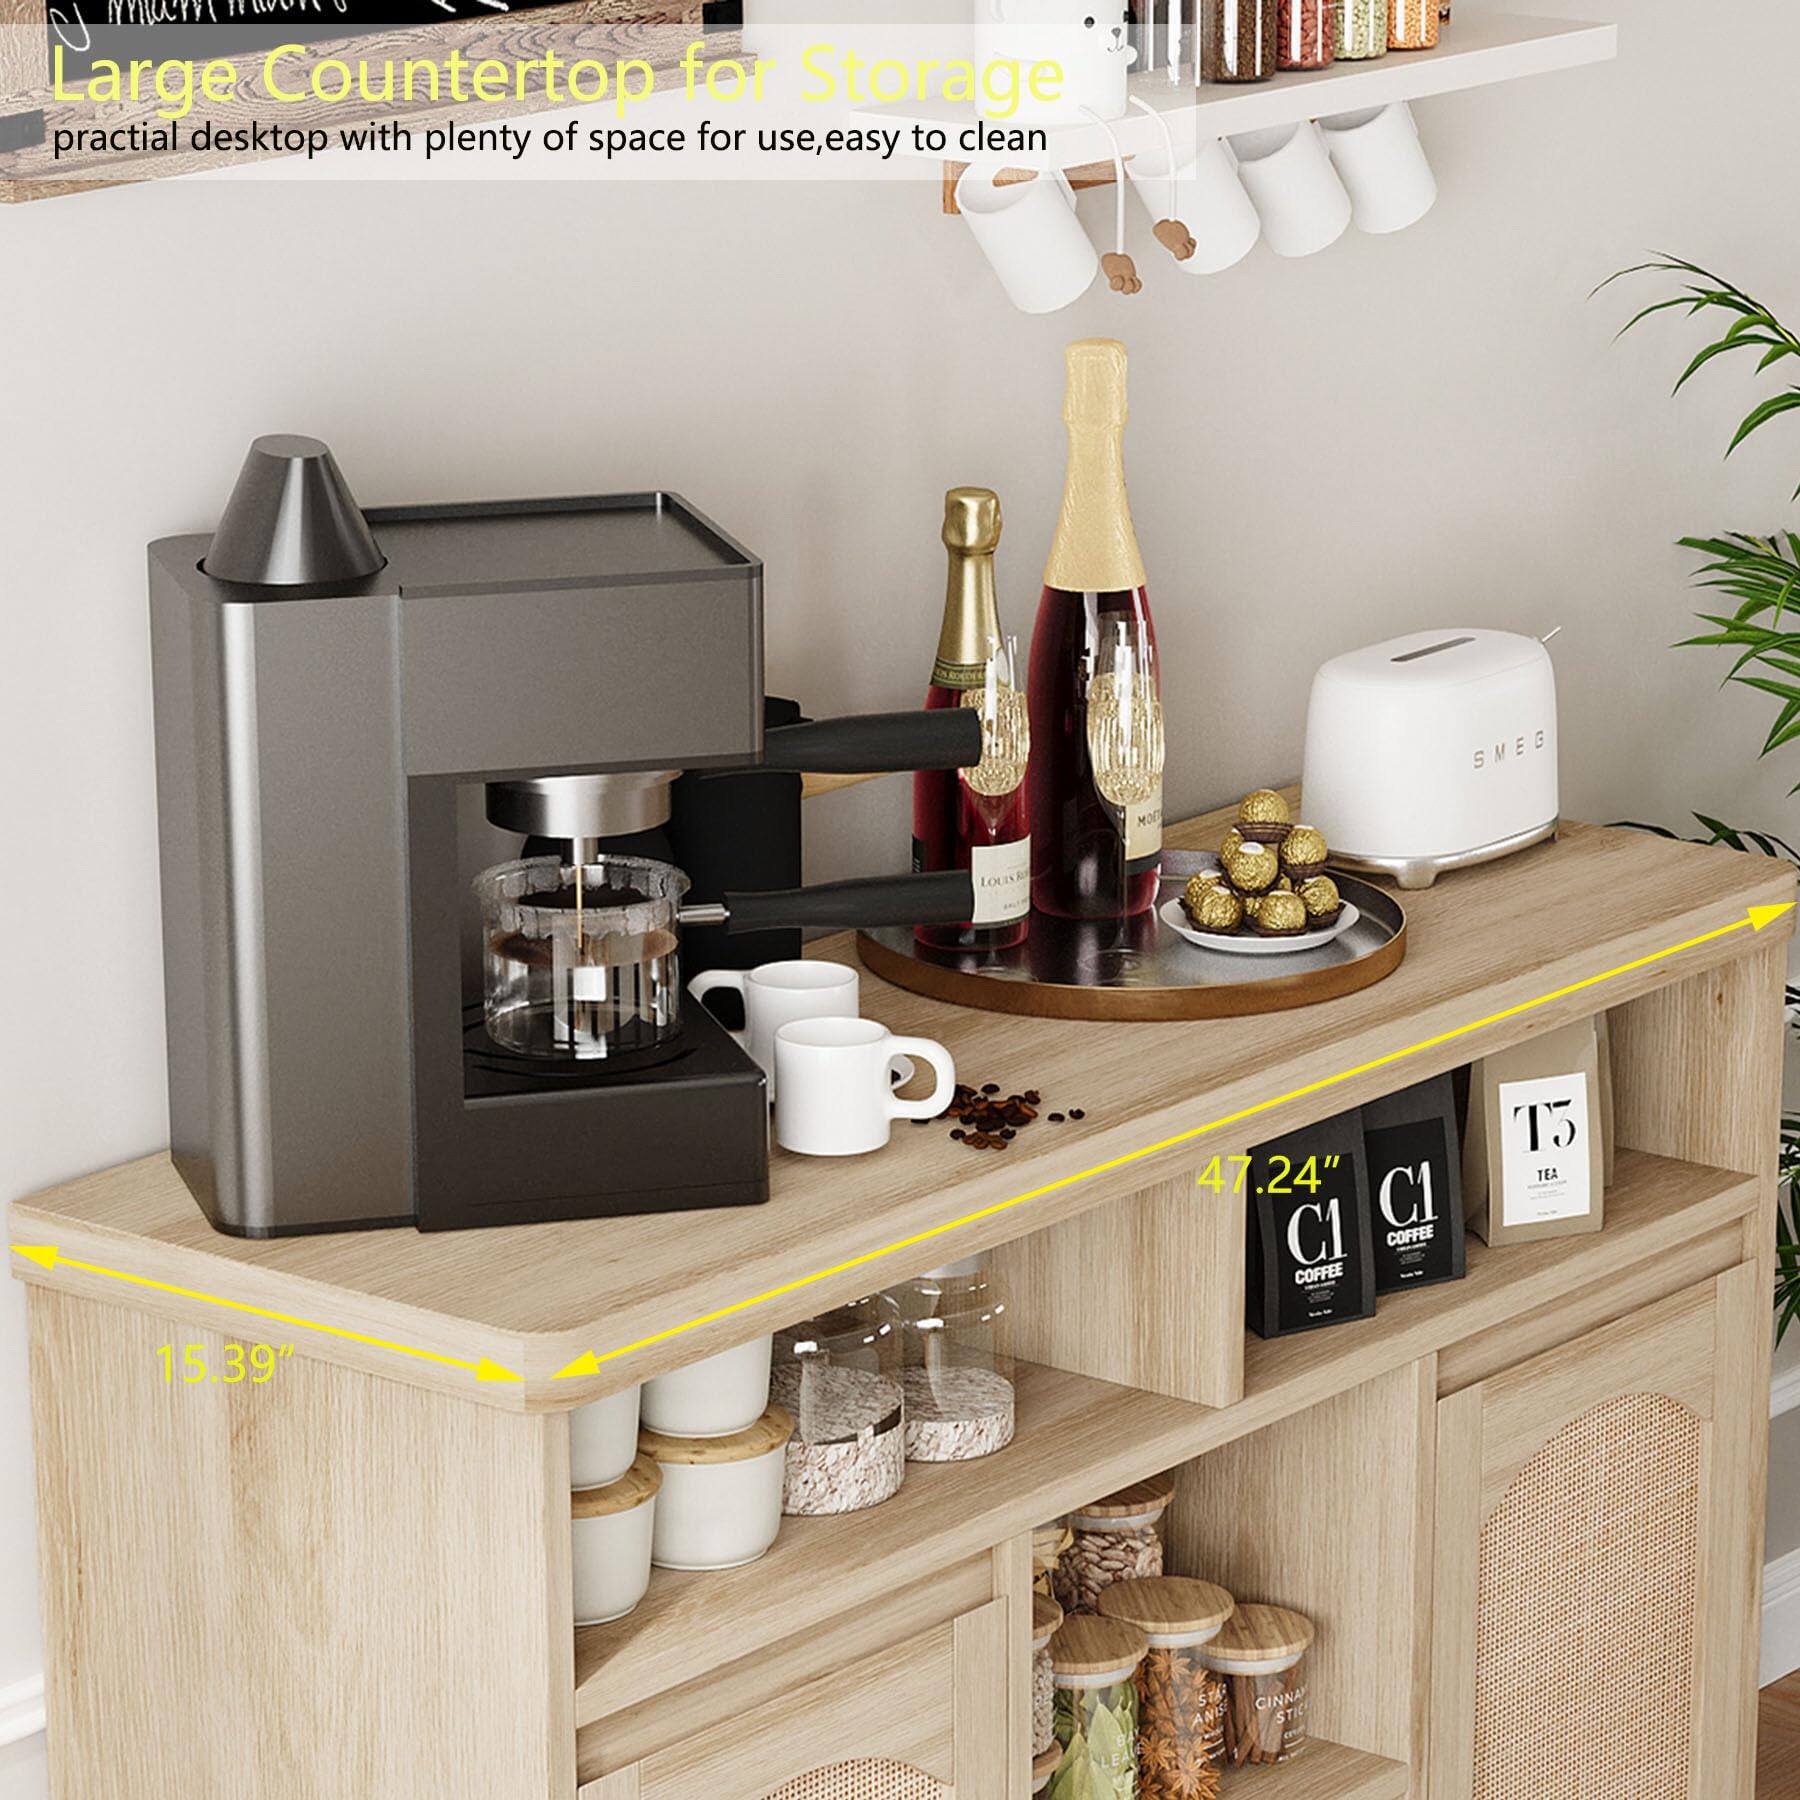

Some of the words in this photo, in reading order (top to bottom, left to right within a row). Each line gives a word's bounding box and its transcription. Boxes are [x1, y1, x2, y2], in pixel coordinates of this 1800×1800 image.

[1473, 729, 1544, 769] SMEG
[1536, 1167, 1559, 1182] TEA
[1378, 1160, 1439, 1228] C1
[1286, 1197, 1348, 1265] C1
[1386, 1223, 1435, 1247] COFFEE
[1294, 1261, 1344, 1285] COFFEE
